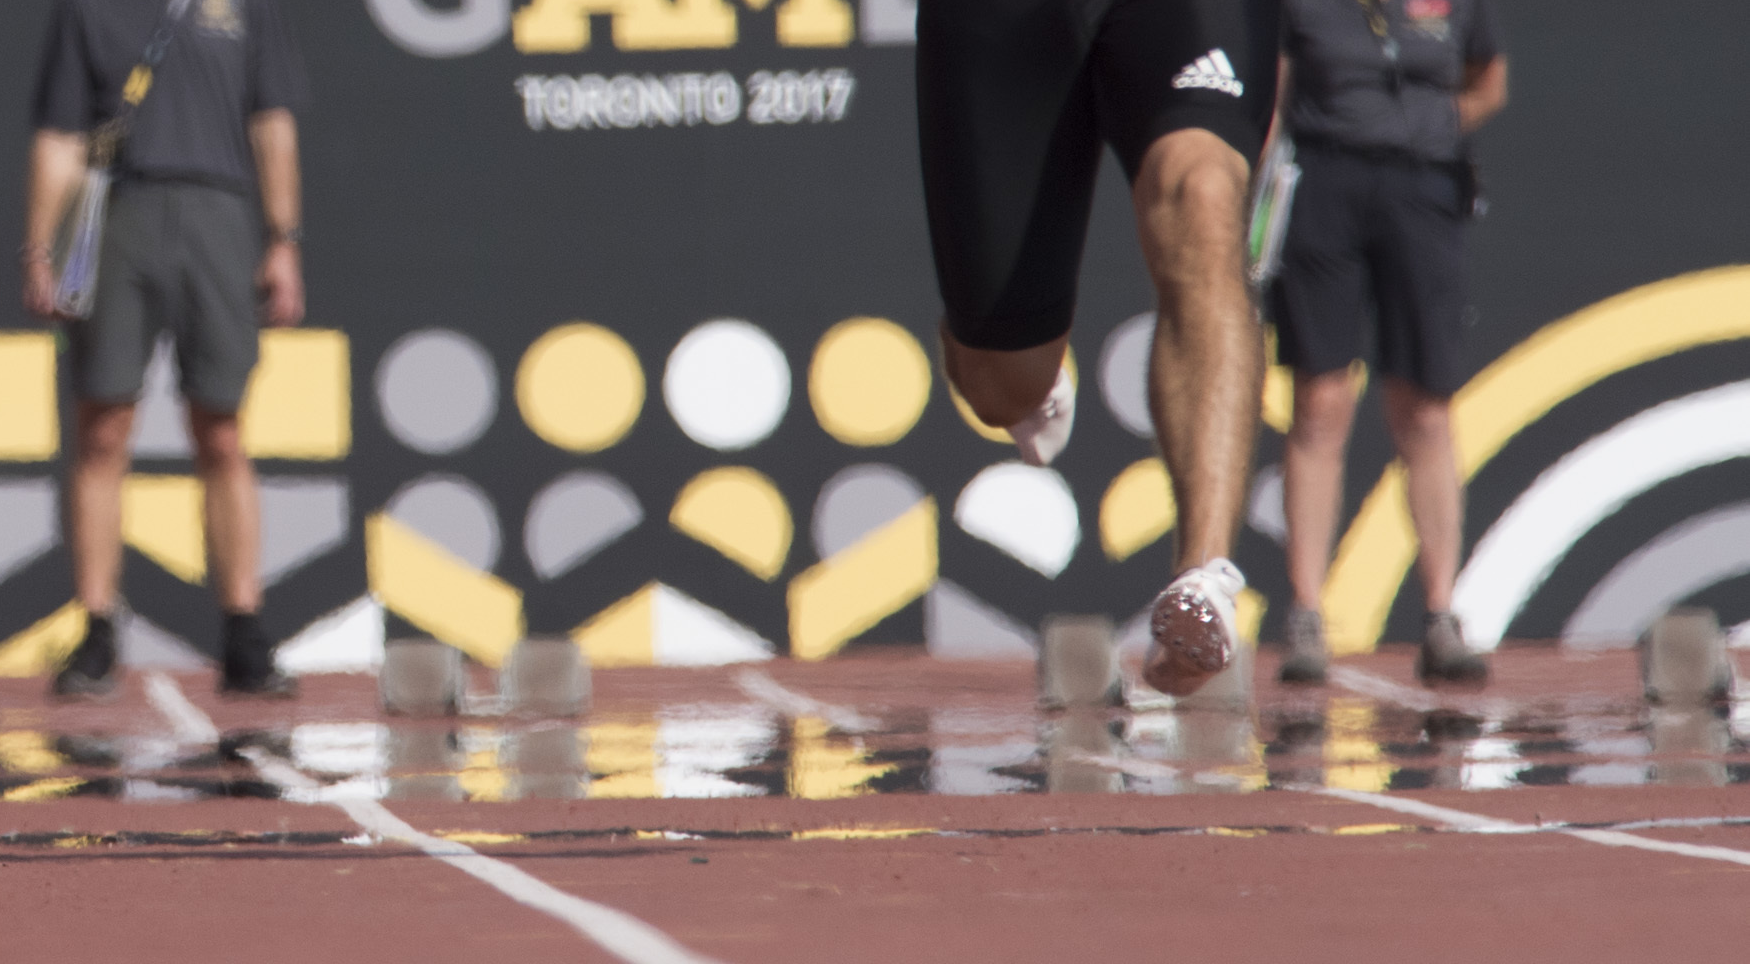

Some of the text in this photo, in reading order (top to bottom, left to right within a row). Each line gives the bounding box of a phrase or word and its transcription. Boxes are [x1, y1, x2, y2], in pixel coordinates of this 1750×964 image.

[514, 67, 856, 130] TORONTO 2017
[1170, 73, 1244, 98] adidas
